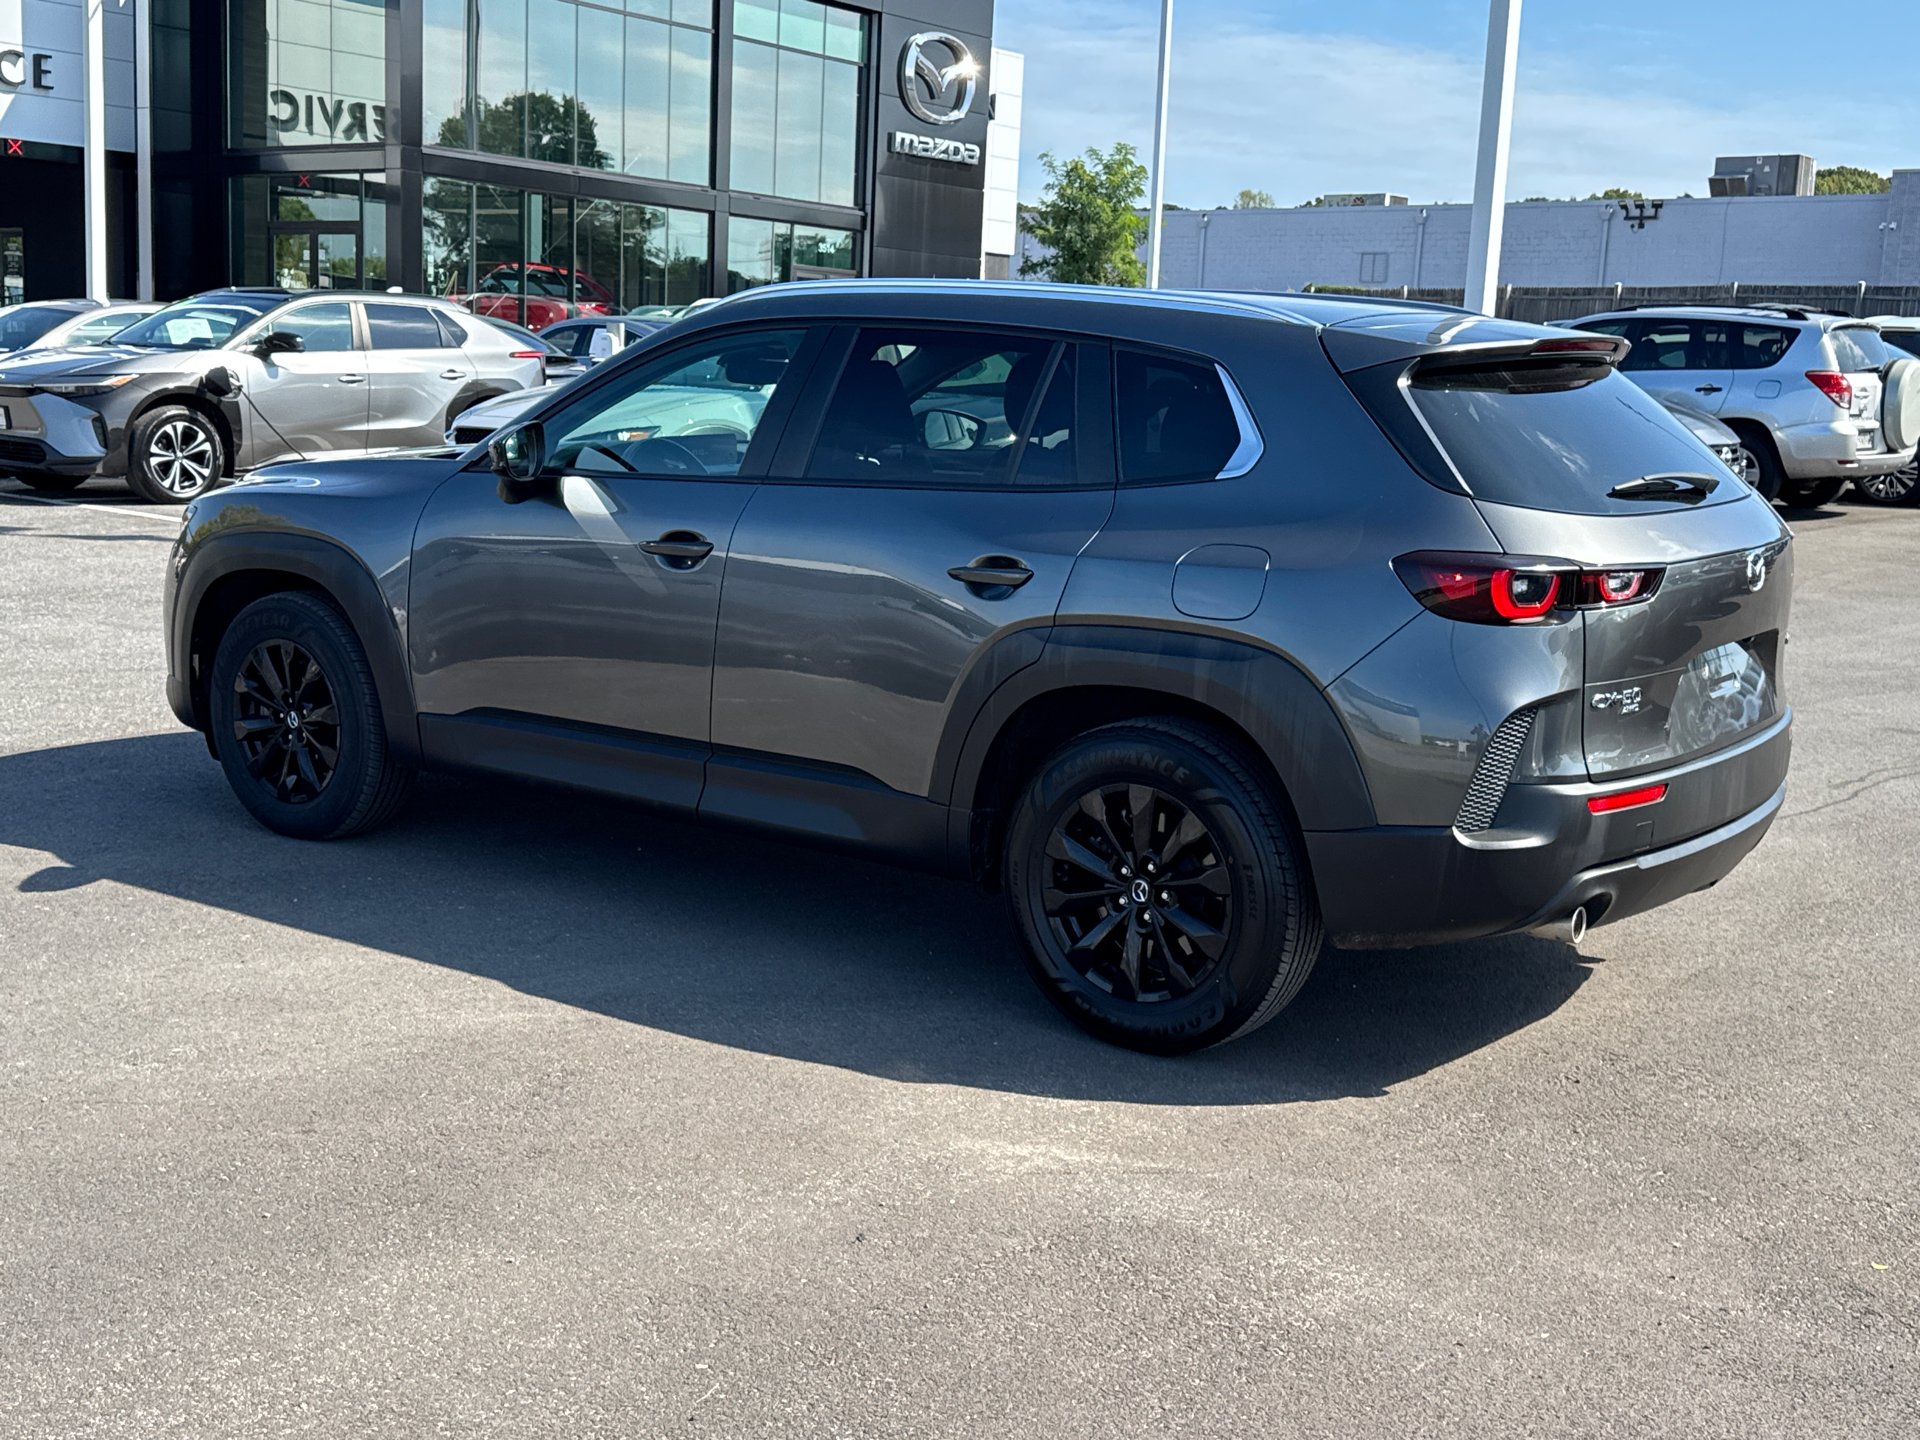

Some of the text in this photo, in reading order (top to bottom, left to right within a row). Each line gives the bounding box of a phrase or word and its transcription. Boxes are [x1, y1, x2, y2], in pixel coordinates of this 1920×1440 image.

[818, 242, 835, 254] 3514
[1591, 687, 1642, 709] CX-50
[1051, 748, 1190, 788] ASSURANCE
